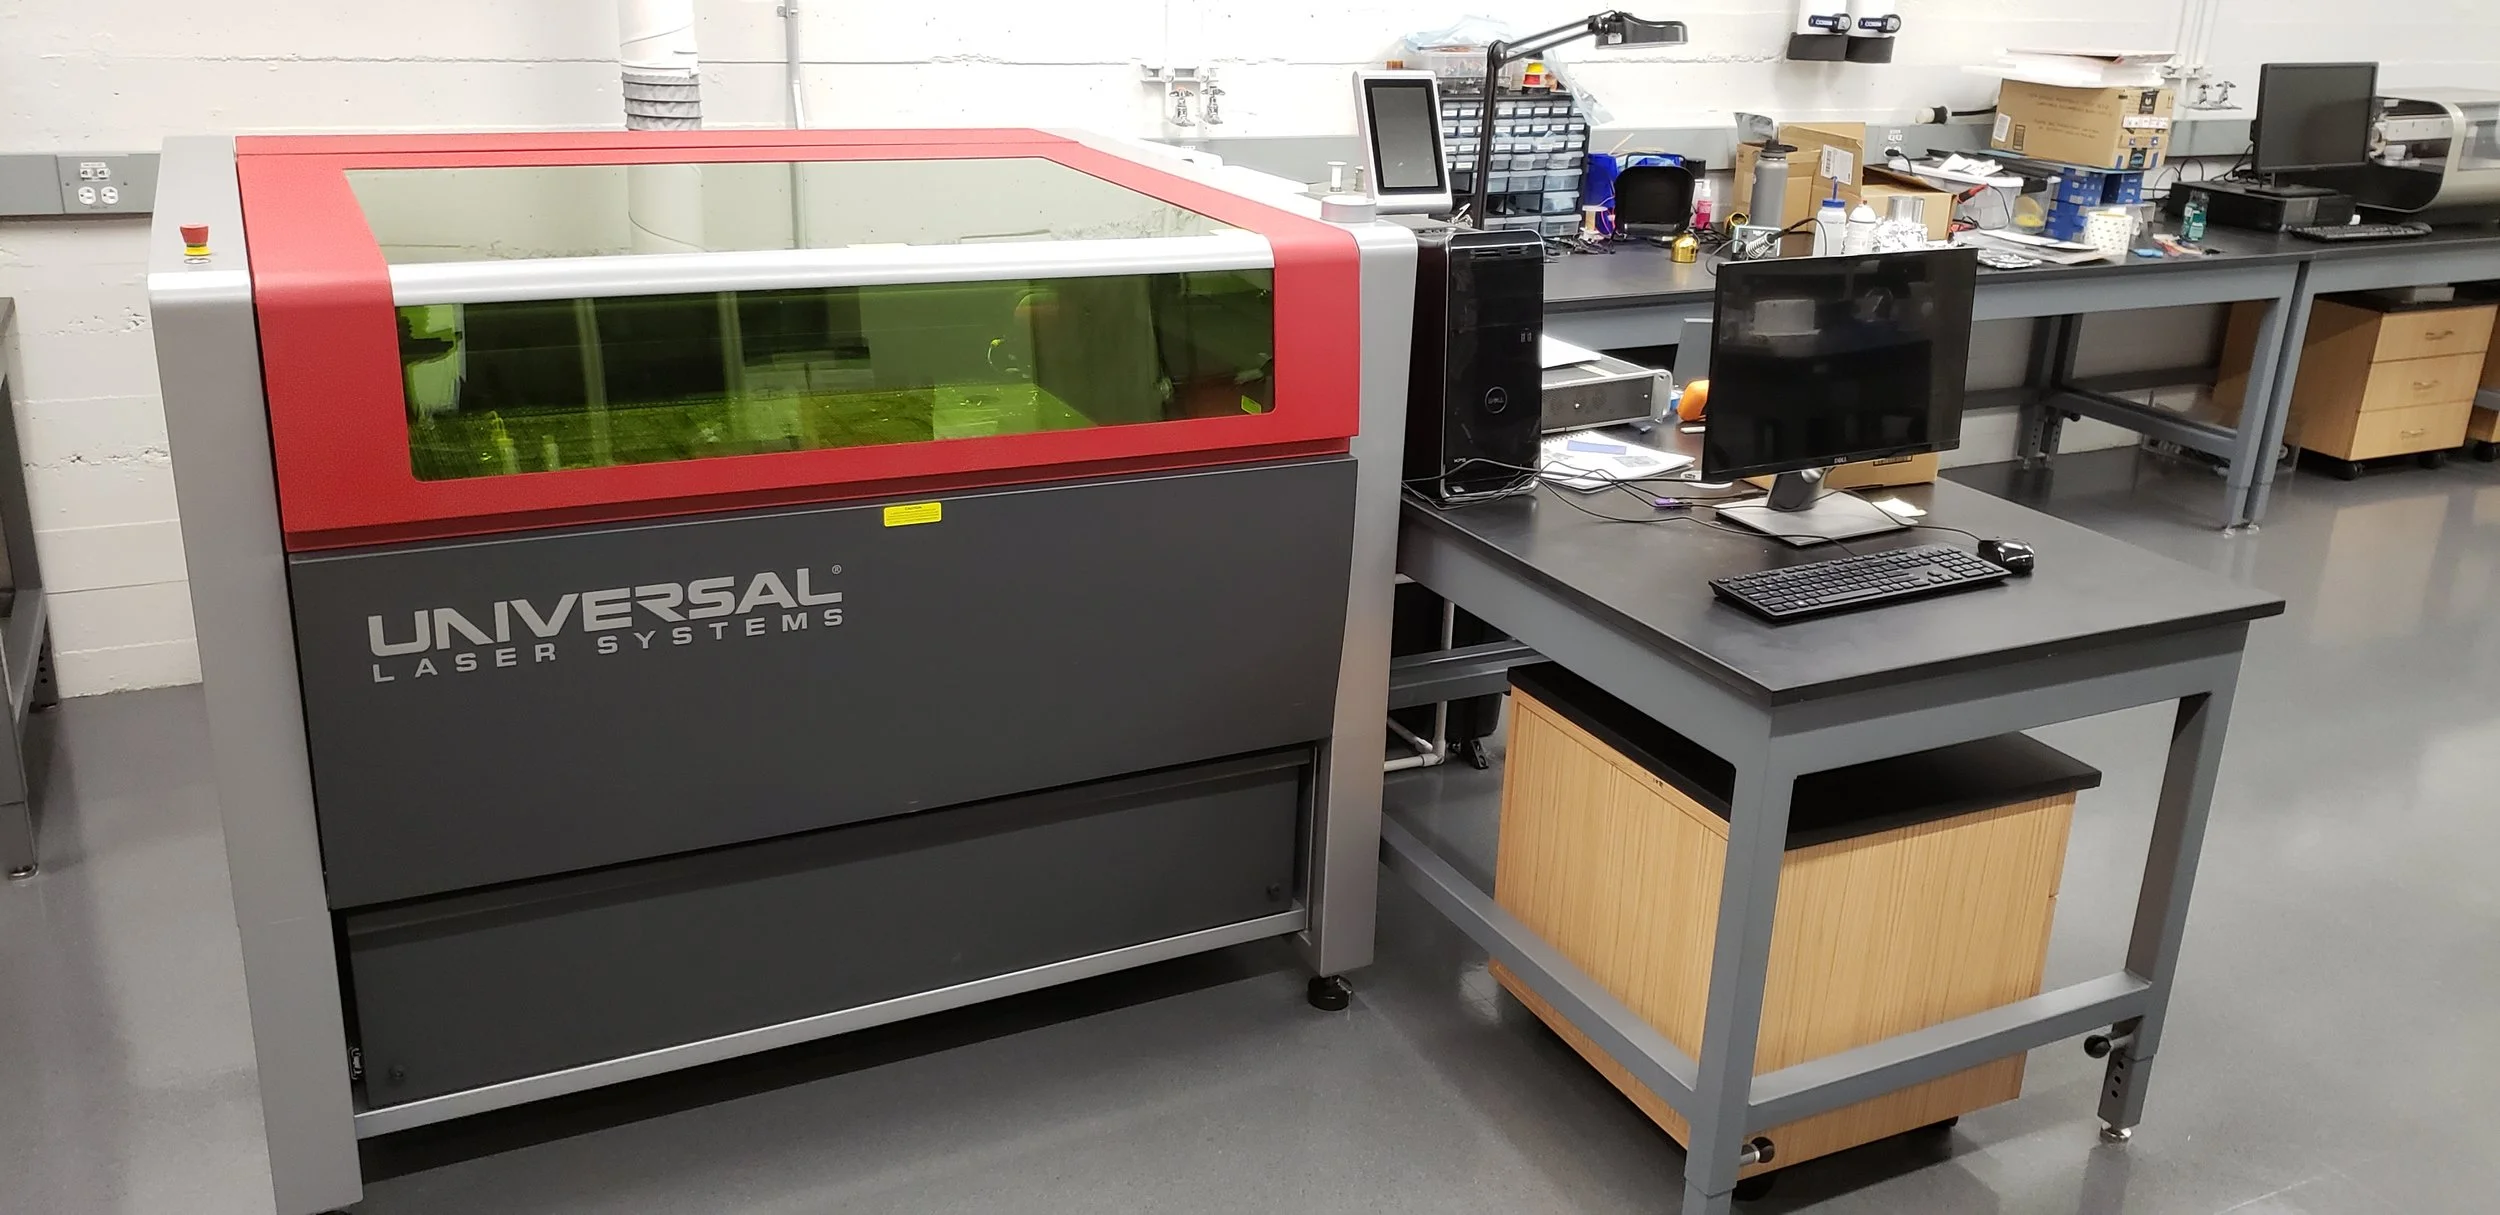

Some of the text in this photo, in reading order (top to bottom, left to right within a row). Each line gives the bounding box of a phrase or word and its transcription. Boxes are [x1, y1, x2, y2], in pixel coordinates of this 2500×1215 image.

[1833, 456, 1847, 464] DELL
[368, 567, 842, 657] UNIVERSAL
[372, 608, 843, 683] LASER SYSTEMS
